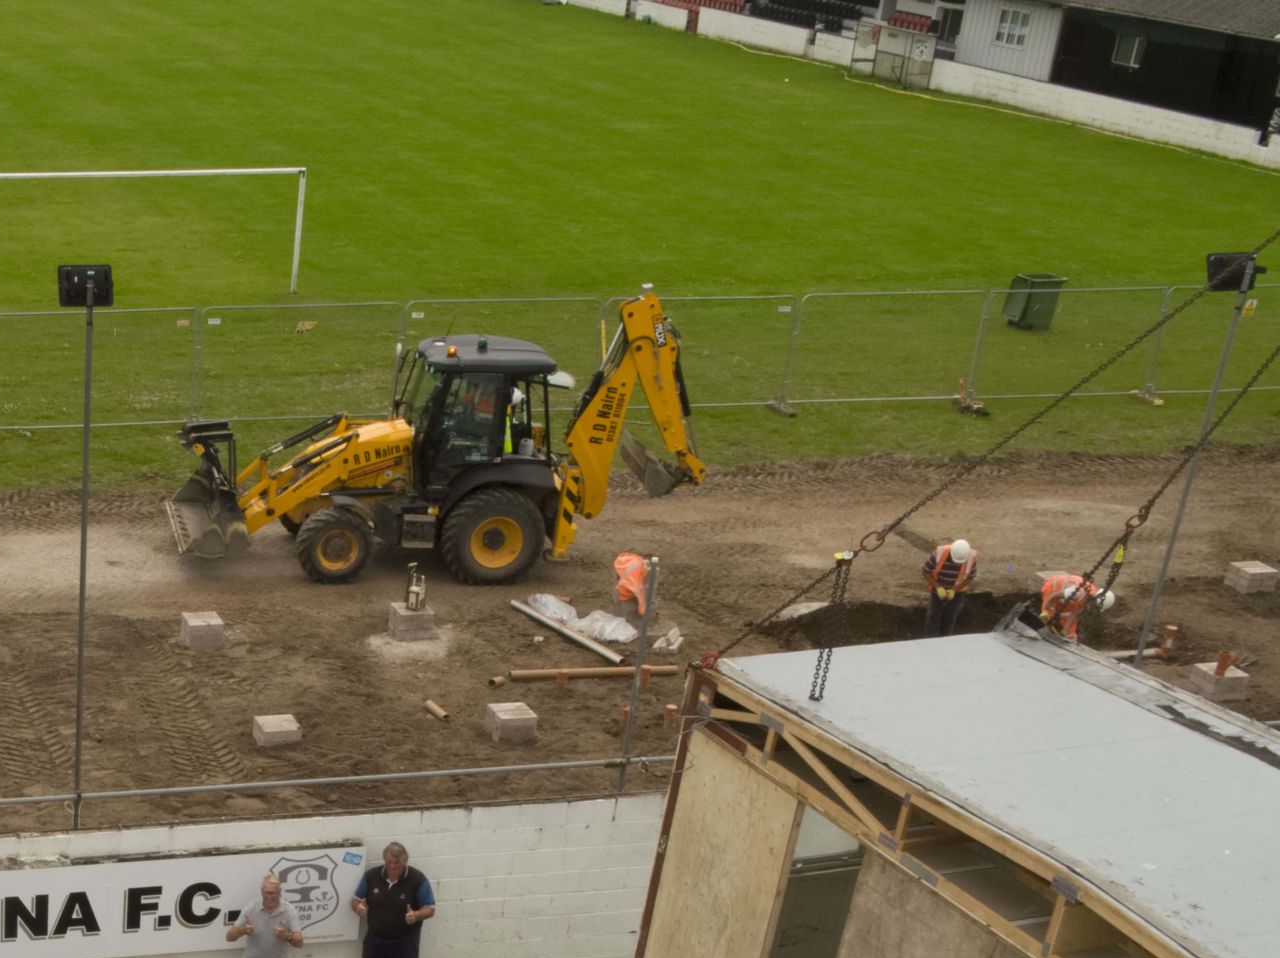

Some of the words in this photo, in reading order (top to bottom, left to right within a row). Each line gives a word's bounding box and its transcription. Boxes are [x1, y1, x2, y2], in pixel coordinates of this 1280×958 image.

[596, 386, 619, 419] Nairn
[592, 423, 607, 432] D
[588, 436, 603, 445] R
[353, 453, 362, 465] R
[363, 451, 372, 463] D
[374, 444, 401, 460] Nairn
[122, 881, 242, 935] F.C.
